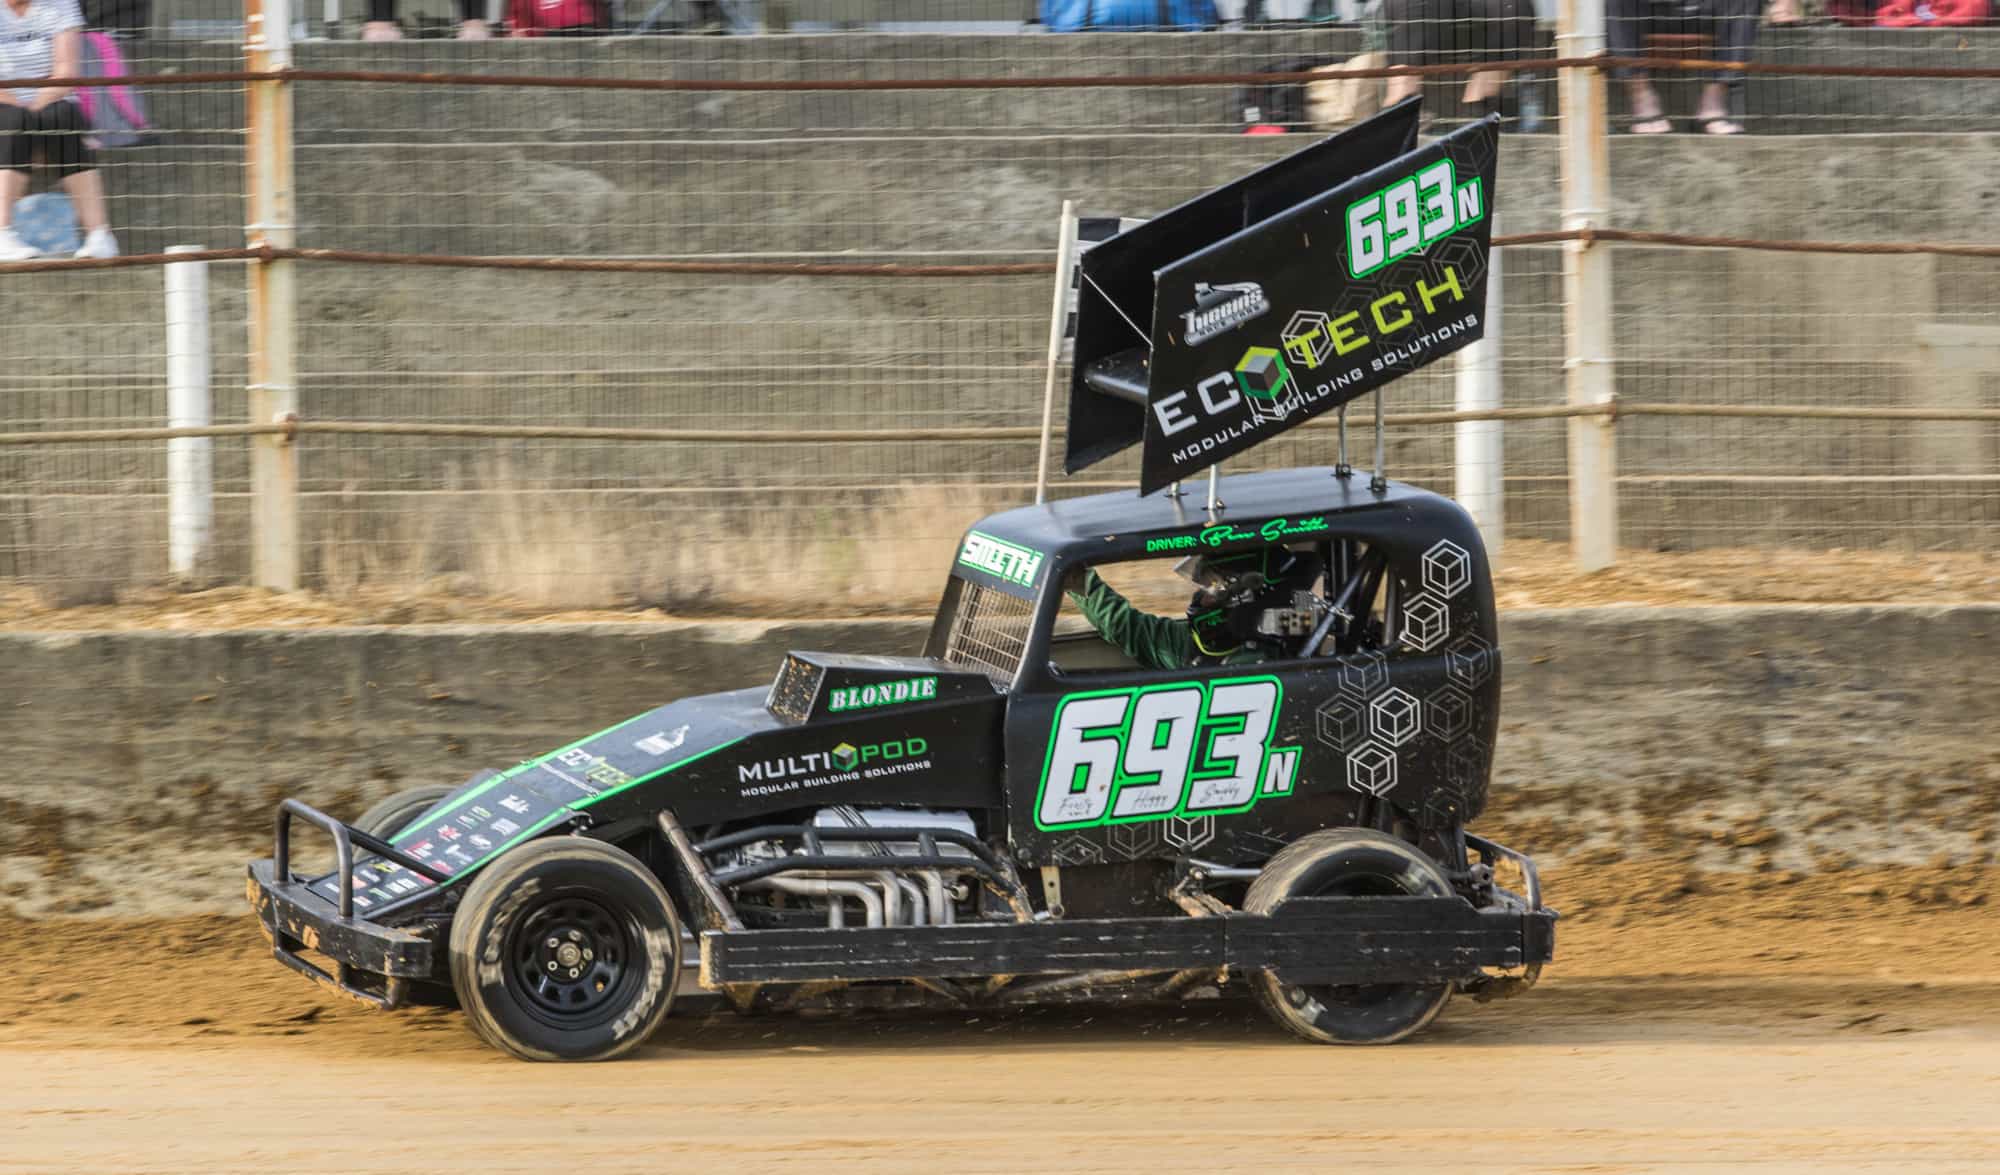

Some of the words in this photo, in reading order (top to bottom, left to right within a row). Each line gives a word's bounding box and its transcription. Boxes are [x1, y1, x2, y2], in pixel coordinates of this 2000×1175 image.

[1347, 160, 1482, 277] 693N
[1171, 414, 1266, 464] MODULAR
[1273, 367, 1364, 418] BUILDING
[1371, 313, 1478, 372] SOLUTIONS
[1146, 534, 1198, 552] DRIVER:
[829, 679, 937, 711] BLONDIE
[741, 781, 799, 797] MODULAR
[803, 771, 860, 787] BUILDING
[864, 760, 932, 778] SOLUTIONS
[1036, 677, 1300, 829] 693N
